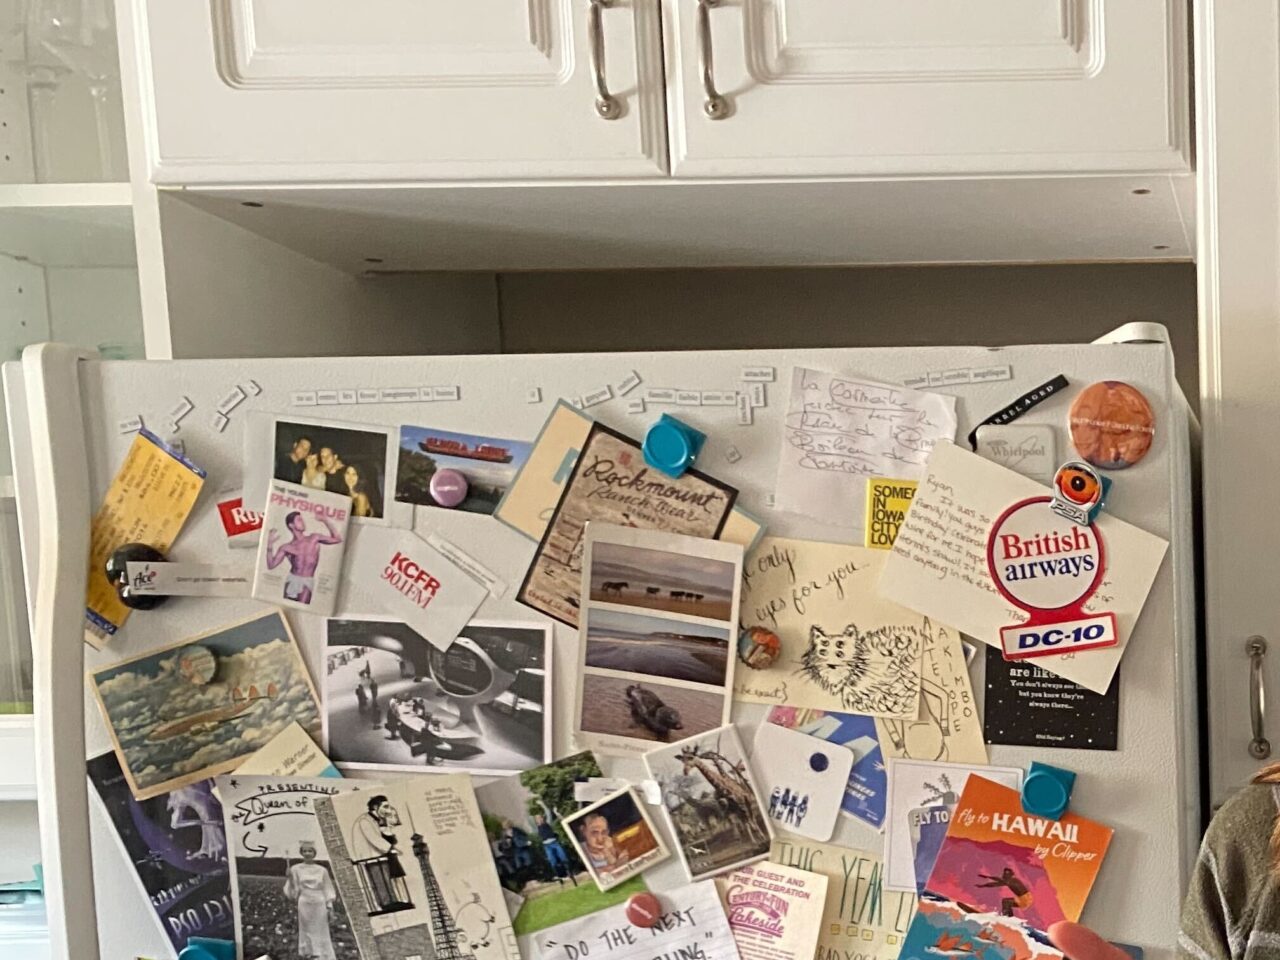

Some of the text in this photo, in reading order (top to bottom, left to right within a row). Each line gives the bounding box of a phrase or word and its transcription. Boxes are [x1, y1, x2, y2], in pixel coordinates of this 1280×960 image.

[991, 444, 1045, 458] Whirlpool
[583, 455, 724, 514] Rockmount
[588, 484, 652, 508] Ranch
[926, 474, 955, 497] Ryan
[269, 494, 347, 522] PHYSIQUE
[872, 509, 905, 522] IOWA
[873, 497, 887, 510] IN
[1051, 502, 1087, 521] PSA
[871, 521, 900, 534] CITY
[1000, 525, 1092, 560] British
[390, 550, 441, 598] KCFR
[758, 546, 794, 583] only
[1005, 553, 1096, 583] airways
[756, 579, 822, 626] eyes for
[1017, 623, 1106, 650] DC-10
[1010, 667, 1030, 678] are
[258, 783, 341, 797] PRESENTING
[250, 797, 292, 818] Queen
[294, 796, 309, 810] of
[914, 811, 949, 827] FLY TO
[957, 808, 1080, 844] fly to HAWAII
[1034, 842, 1098, 862] by Clipper
[732, 874, 811, 900] THE CELEBRATION
[757, 868, 785, 883] GUEST
[786, 877, 806, 889] AND
[599, 925, 637, 951] THE
[650, 905, 697, 936] NEXT
[728, 906, 786, 937] Lakeside
